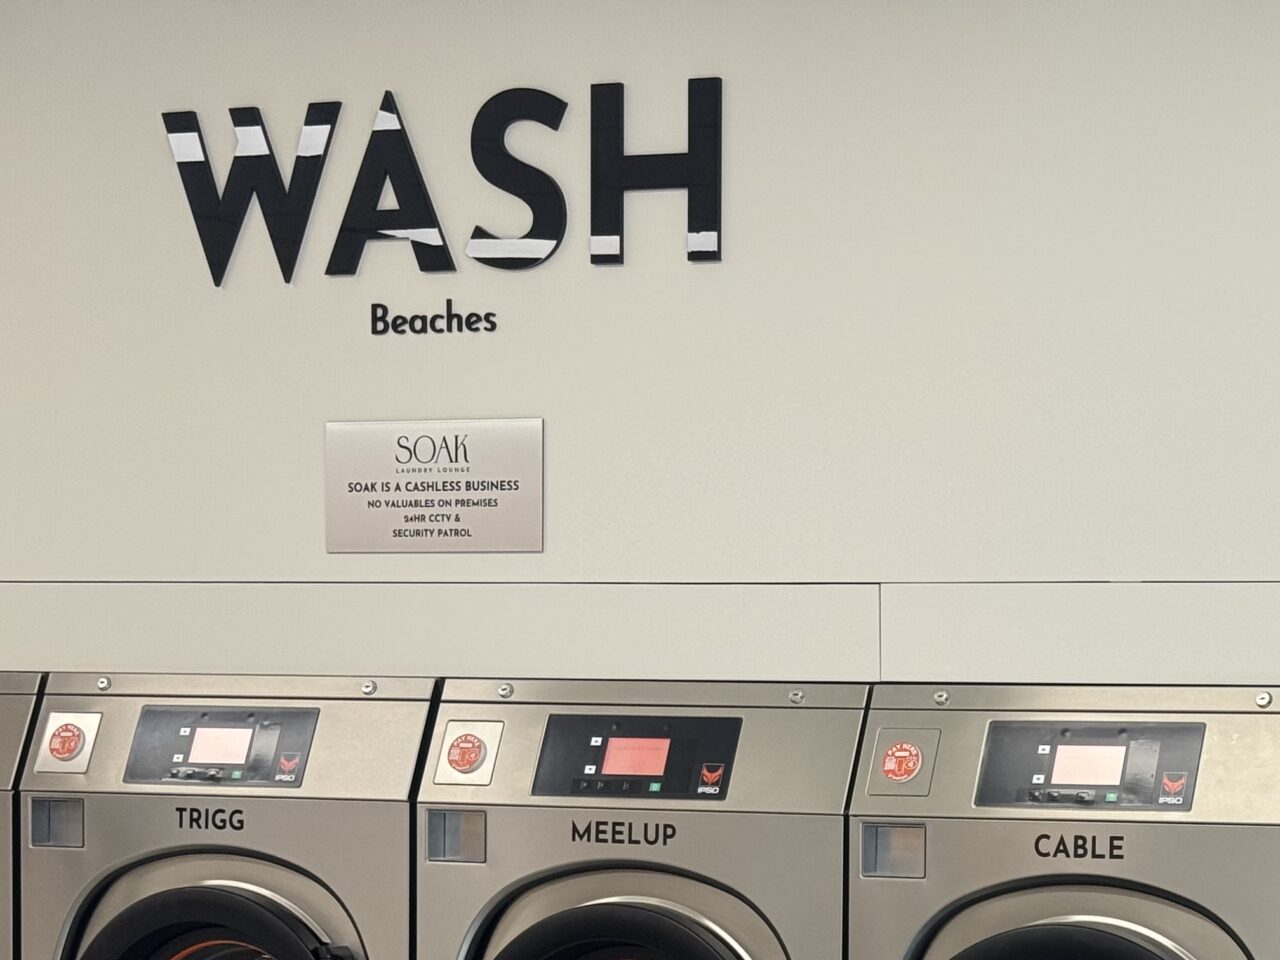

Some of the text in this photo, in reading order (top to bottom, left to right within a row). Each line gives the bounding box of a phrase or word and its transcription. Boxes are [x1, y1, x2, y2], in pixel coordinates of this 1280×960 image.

[161, 76, 722, 288] WASH
[371, 298, 498, 336] Beaches
[395, 434, 470, 464] SOAK
[347, 480, 519, 492] SOAK IS A CASHLESS BUSINESS
[367, 498, 498, 508] NO VALUABLES ON PREMISES
[403, 513, 460, 522] 24HR CCTV &
[392, 528, 472, 537] SECURITY PATROL
[1158, 797, 1183, 805] IPSO
[175, 807, 245, 831] TRIGG
[570, 819, 677, 846] MEELUP
[1034, 833, 1125, 860] CABLE
